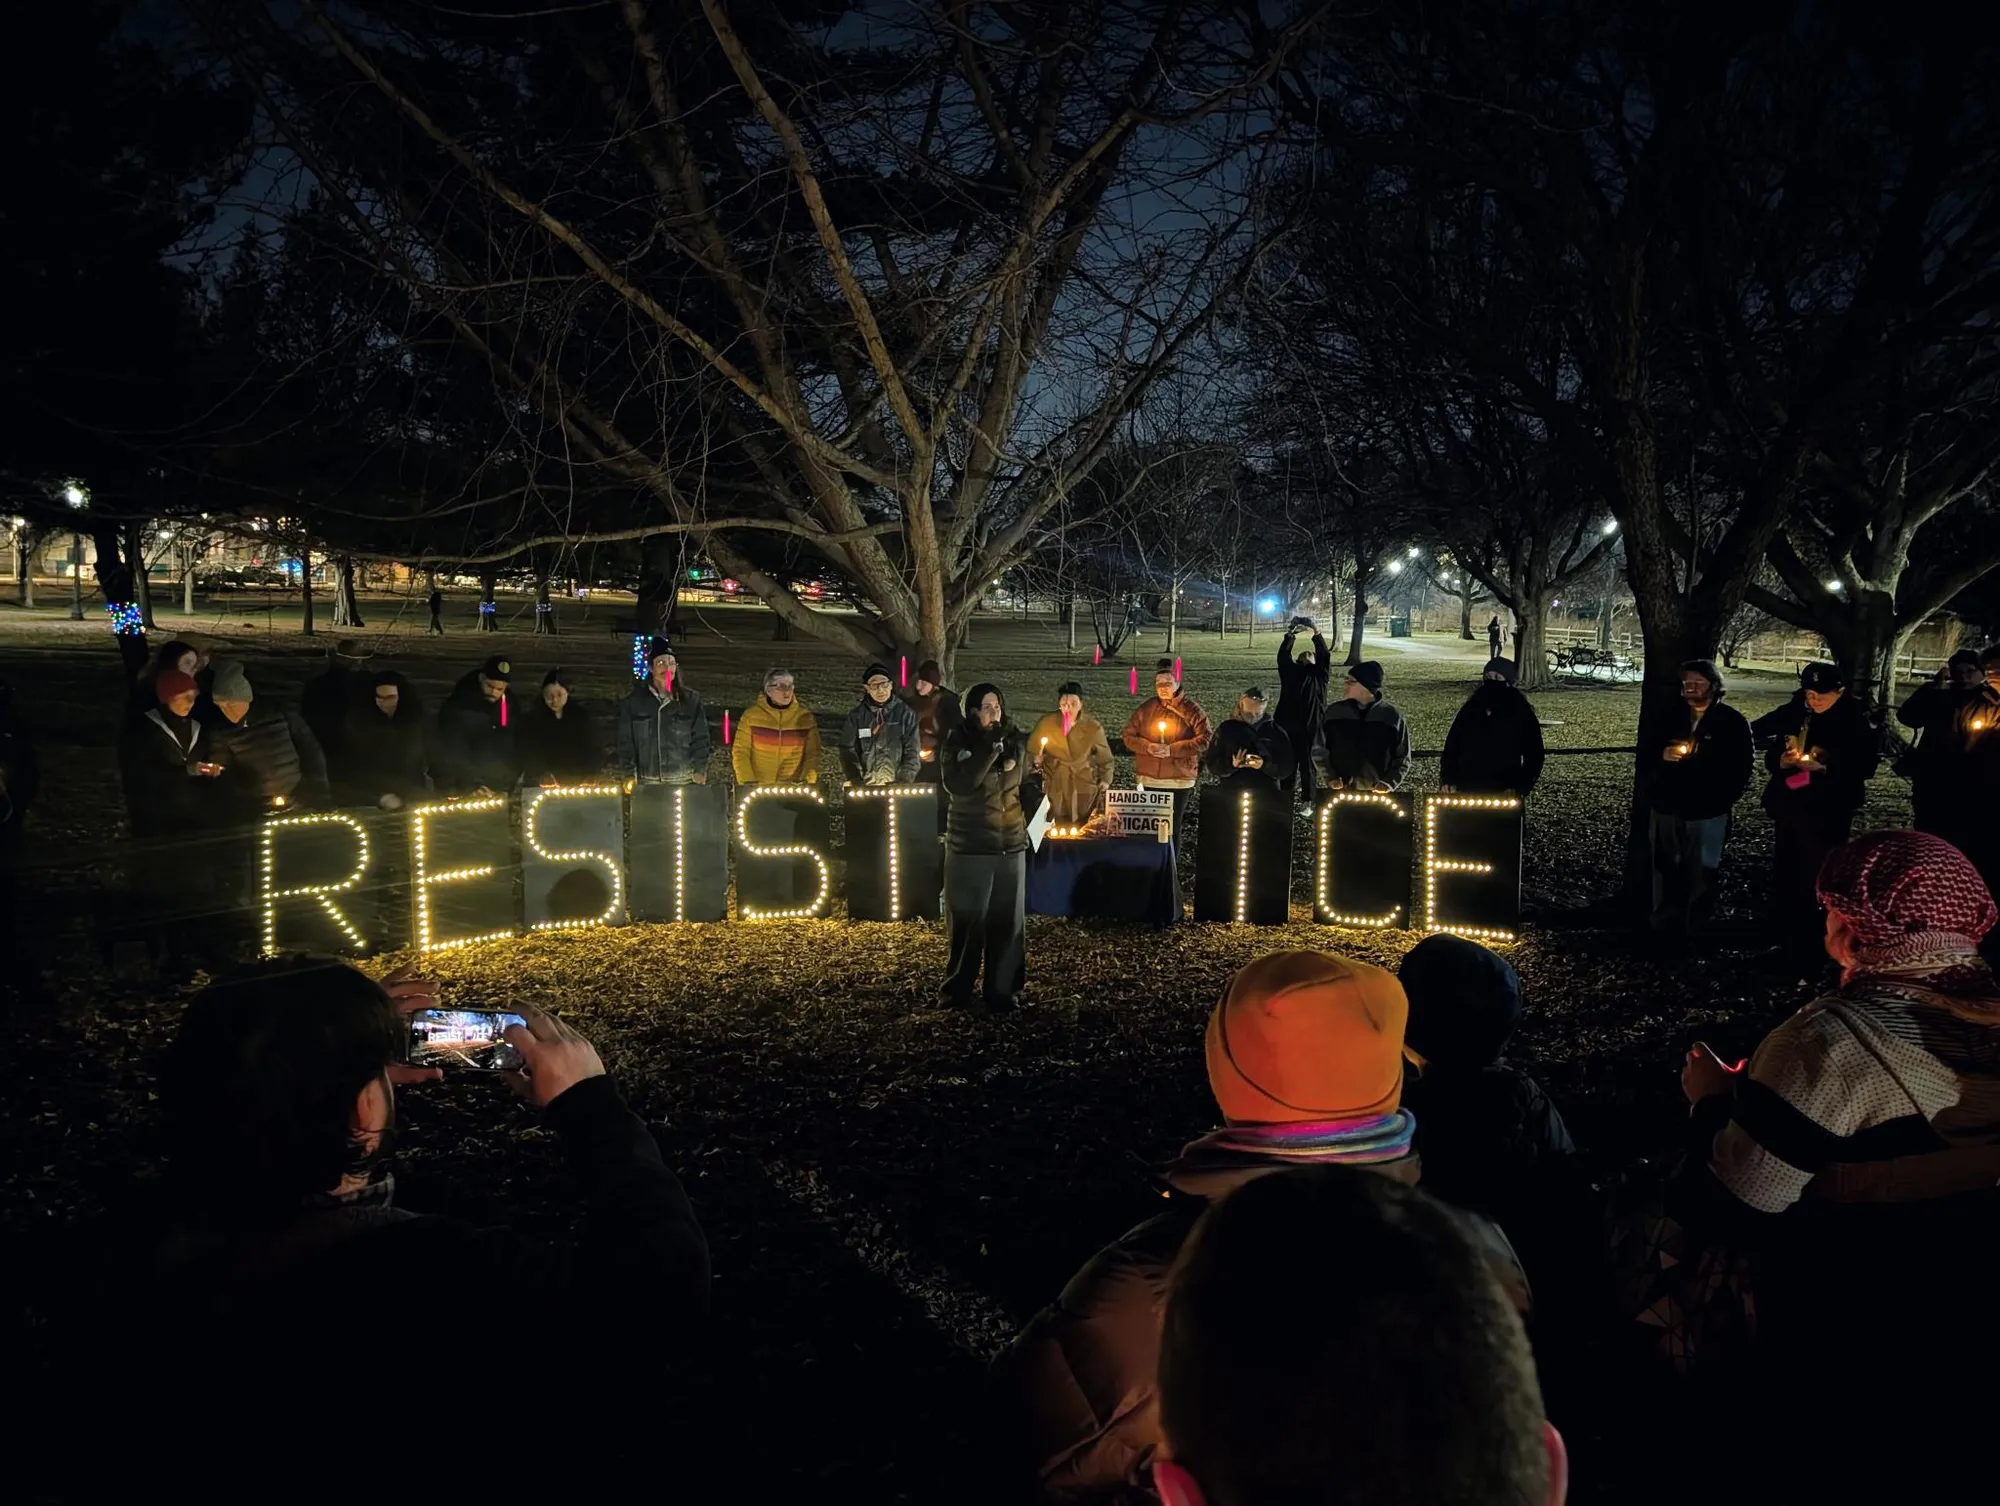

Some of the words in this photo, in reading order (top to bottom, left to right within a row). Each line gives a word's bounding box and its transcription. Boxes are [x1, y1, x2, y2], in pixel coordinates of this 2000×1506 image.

[1109, 792, 1147, 803] HANDS
[1150, 793, 1171, 804] OFF
[1111, 817, 1171, 832] HICAG
[260, 786, 936, 957] RESIST
[1235, 791, 1519, 940] ICE
